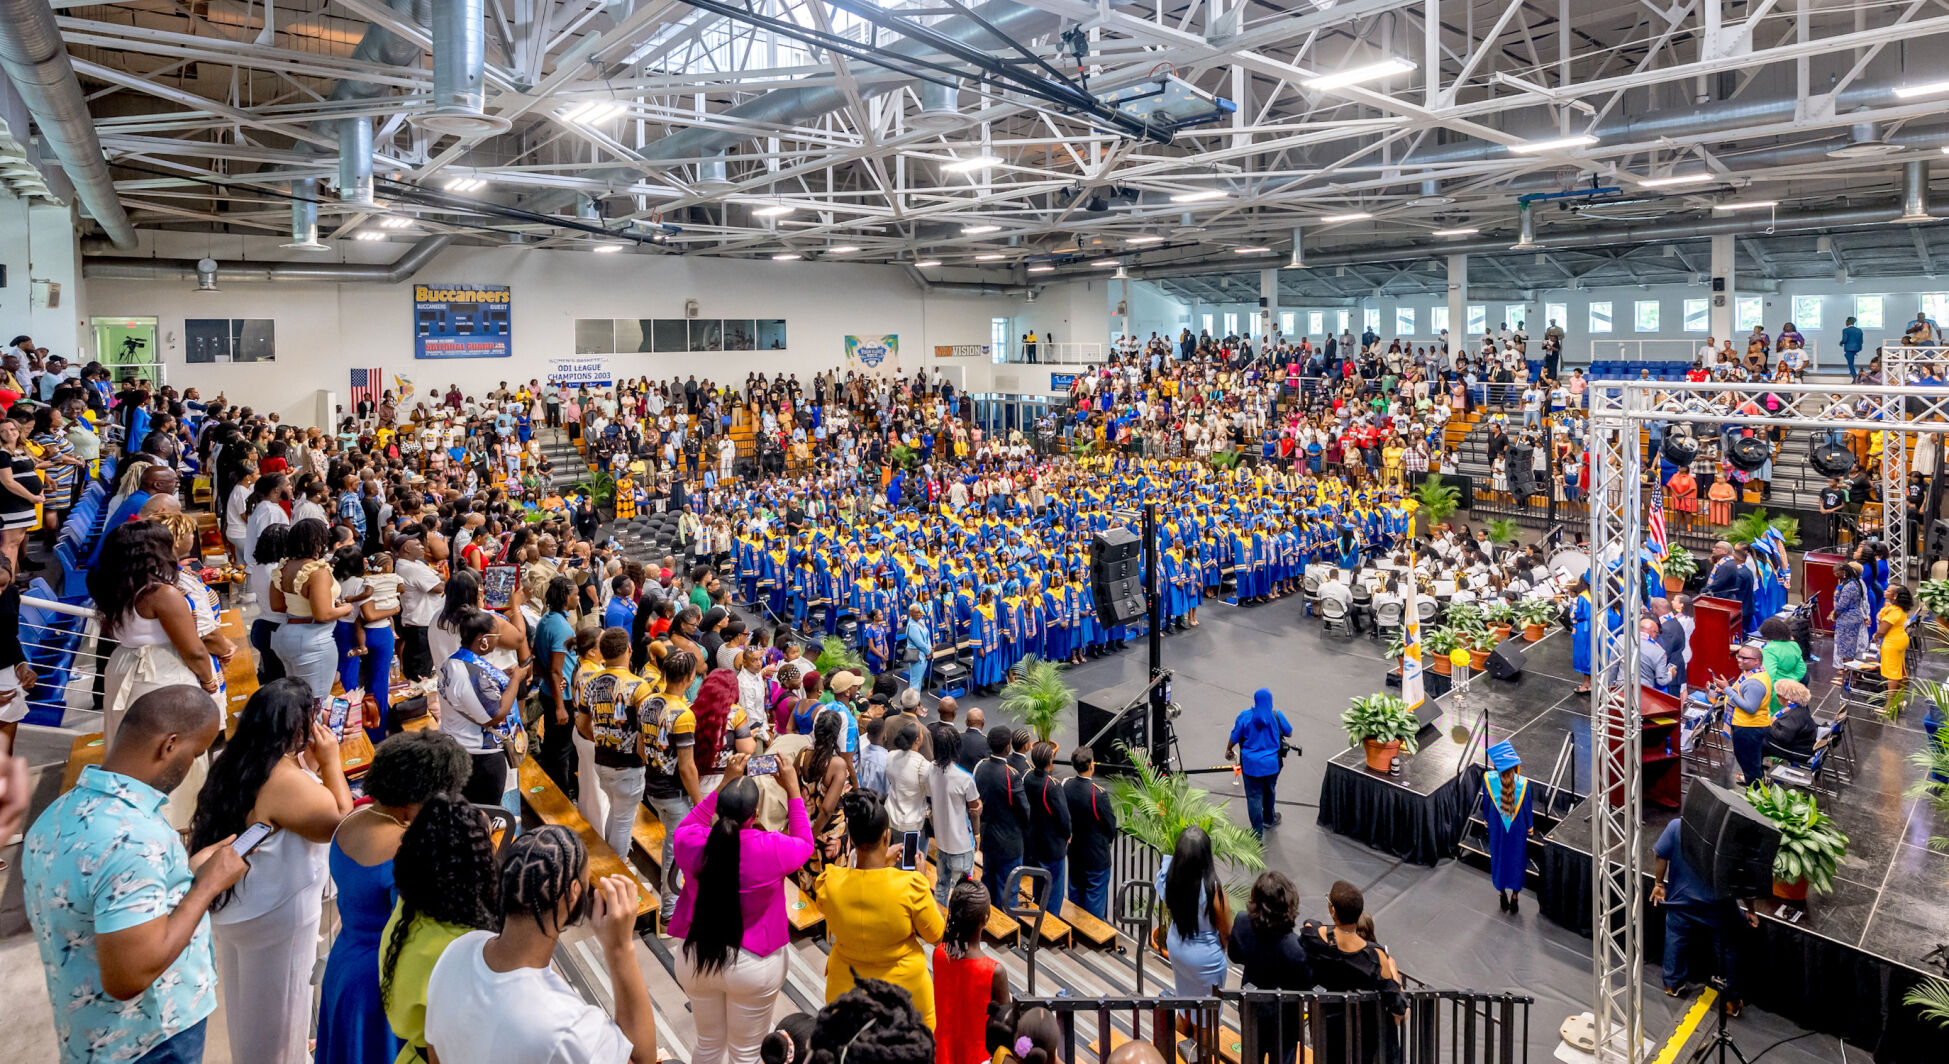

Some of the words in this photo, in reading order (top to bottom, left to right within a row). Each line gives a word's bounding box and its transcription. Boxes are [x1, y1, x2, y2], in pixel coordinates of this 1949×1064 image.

[416, 287, 510, 303] Buccaneers
[547, 373, 592, 381] CHAMPIONS
[594, 371, 611, 380] 2003
